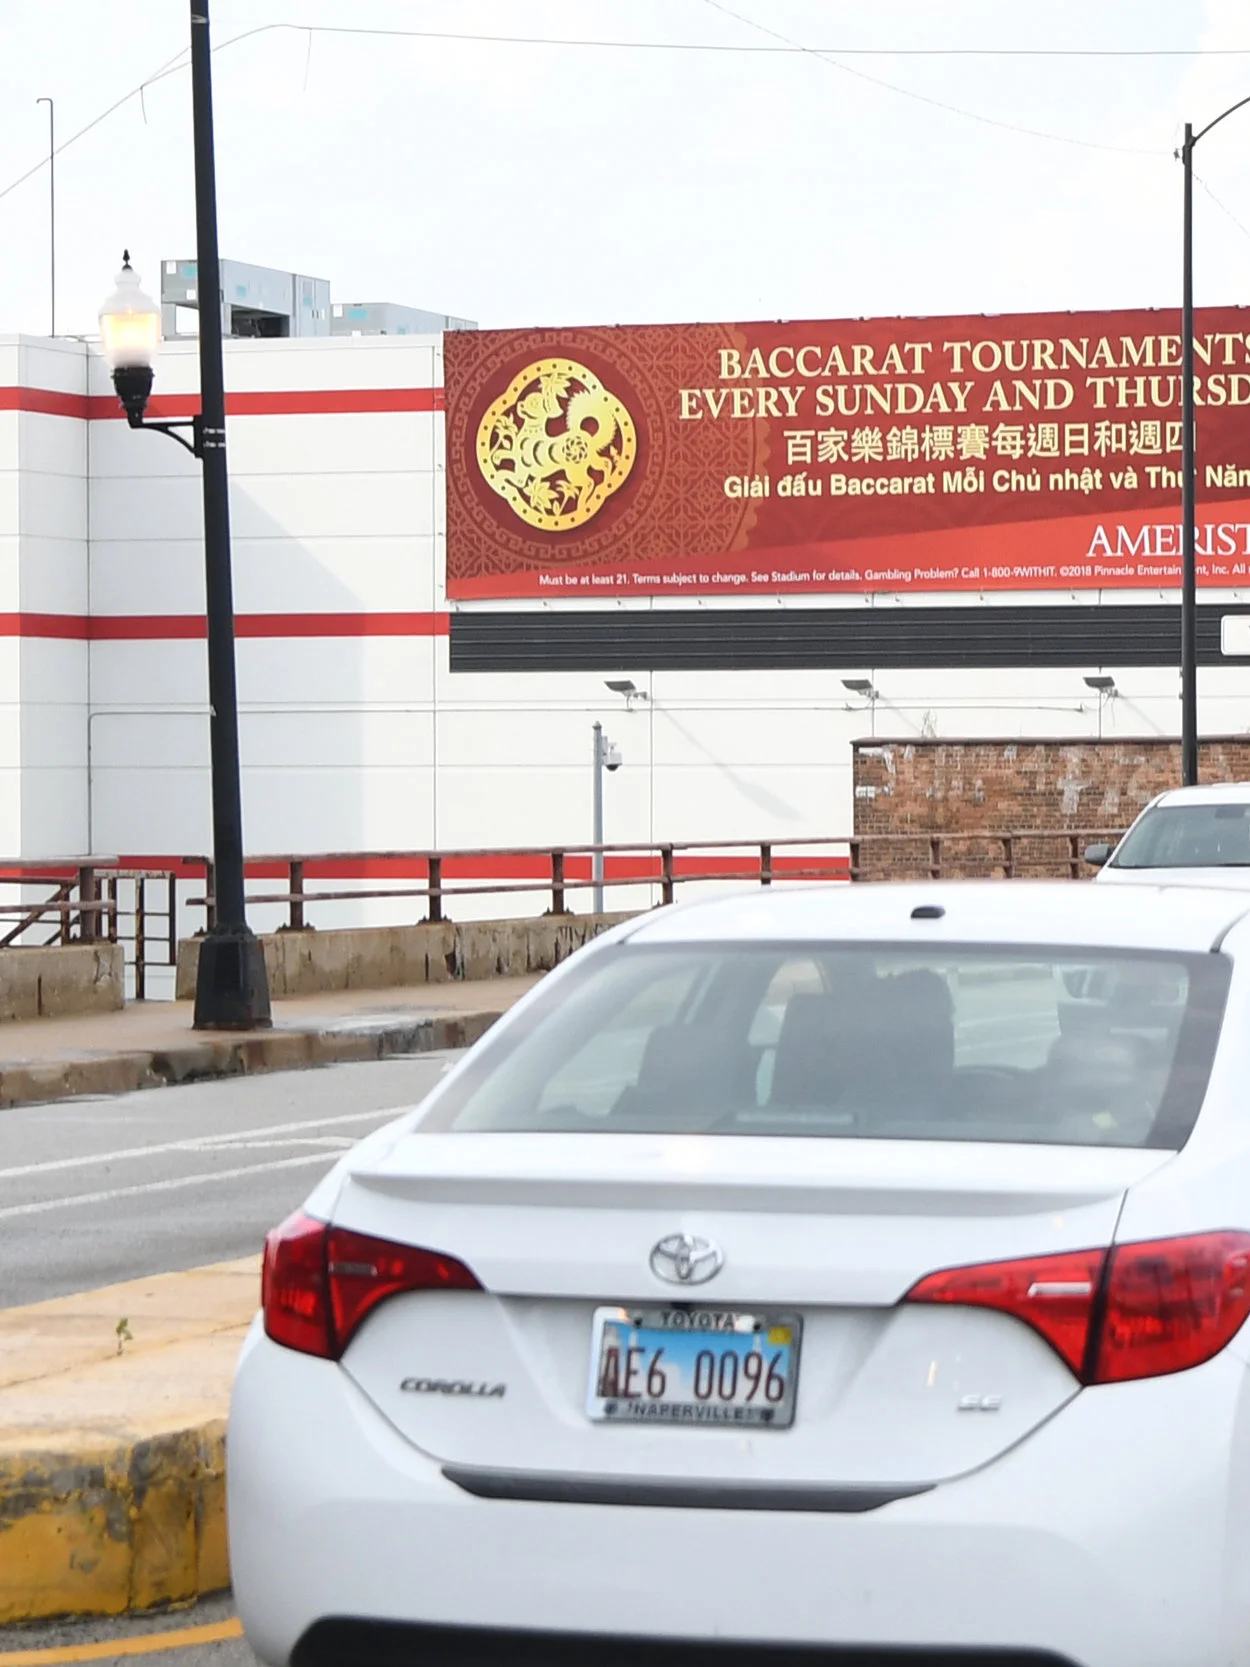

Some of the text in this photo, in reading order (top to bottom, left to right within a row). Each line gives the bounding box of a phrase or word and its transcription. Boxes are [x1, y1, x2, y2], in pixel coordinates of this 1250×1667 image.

[718, 342, 933, 380] BACCARAT
[678, 386, 806, 420] EVERY
[815, 381, 975, 416] SUNDAY
[982, 378, 1074, 412] AND
[830, 472, 936, 497] Baccarat
[1109, 466, 1138, 489] và
[539, 574, 563, 585] Must
[565, 574, 578, 584] be
[580, 574, 590, 584] at
[592, 573, 614, 584] least
[632, 573, 661, 584] Terms
[663, 572, 697, 586] subject
[699, 573, 709, 583] to
[711, 572, 748, 585] change.
[751, 572, 769, 582] See
[771, 571, 810, 582] Stadium
[812, 570, 825, 581] for
[828, 569, 862, 581] details.
[865, 568, 912, 582] Gambling
[914, 567, 958, 579] Problem?
[961, 567, 980, 578] Call
[1094, 564, 1134, 576] Pinnacle
[1137, 563, 1209, 576] Entertainnt,
[1212, 563, 1229, 574] Inc.
[1232, 562, 1245, 574] All
[660, 1311, 736, 1330] TOYOTA
[400, 1377, 507, 1399] COROLLA
[600, 1346, 785, 1403] AE6 0096
